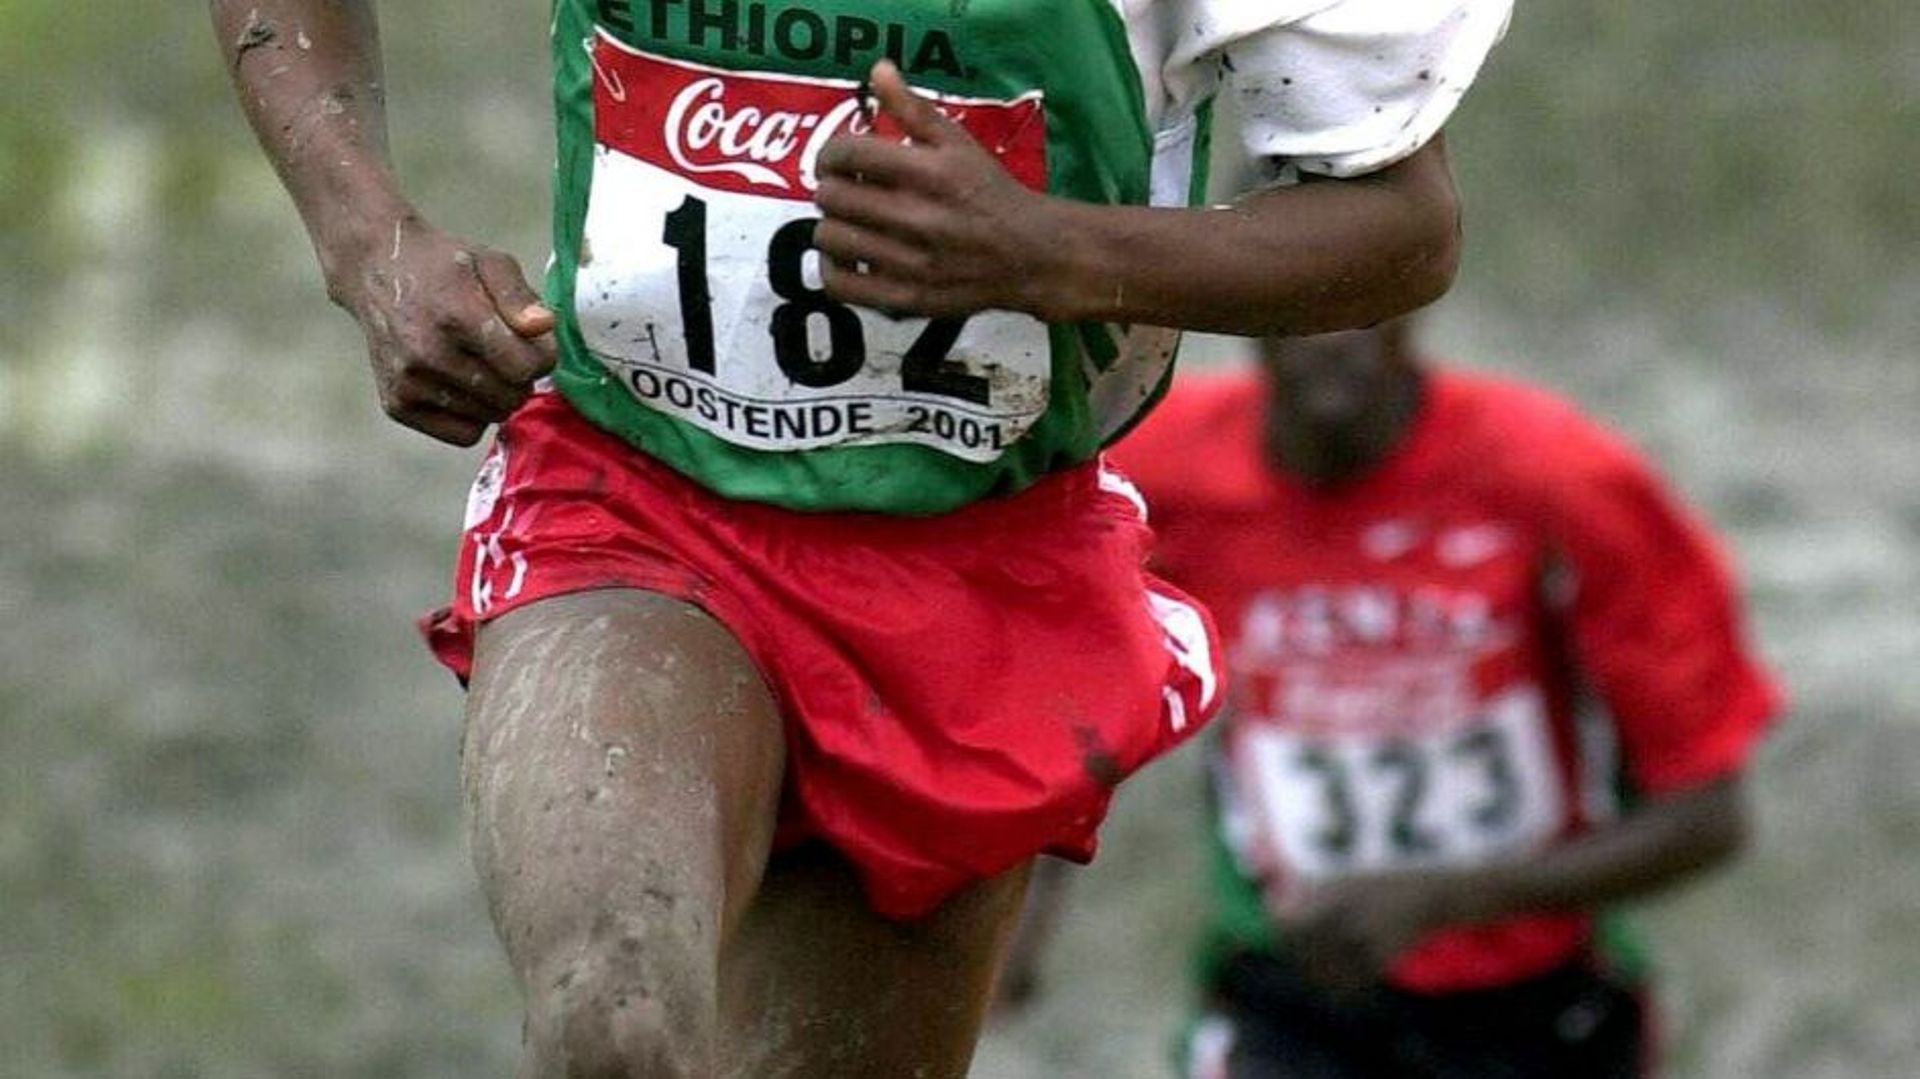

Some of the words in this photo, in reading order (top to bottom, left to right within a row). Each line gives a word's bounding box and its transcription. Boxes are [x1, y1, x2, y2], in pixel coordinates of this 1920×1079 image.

[663, 77, 888, 191] Coca-C
[630, 367, 873, 440] OOSTENDE
[906, 404, 1003, 451] 2001
